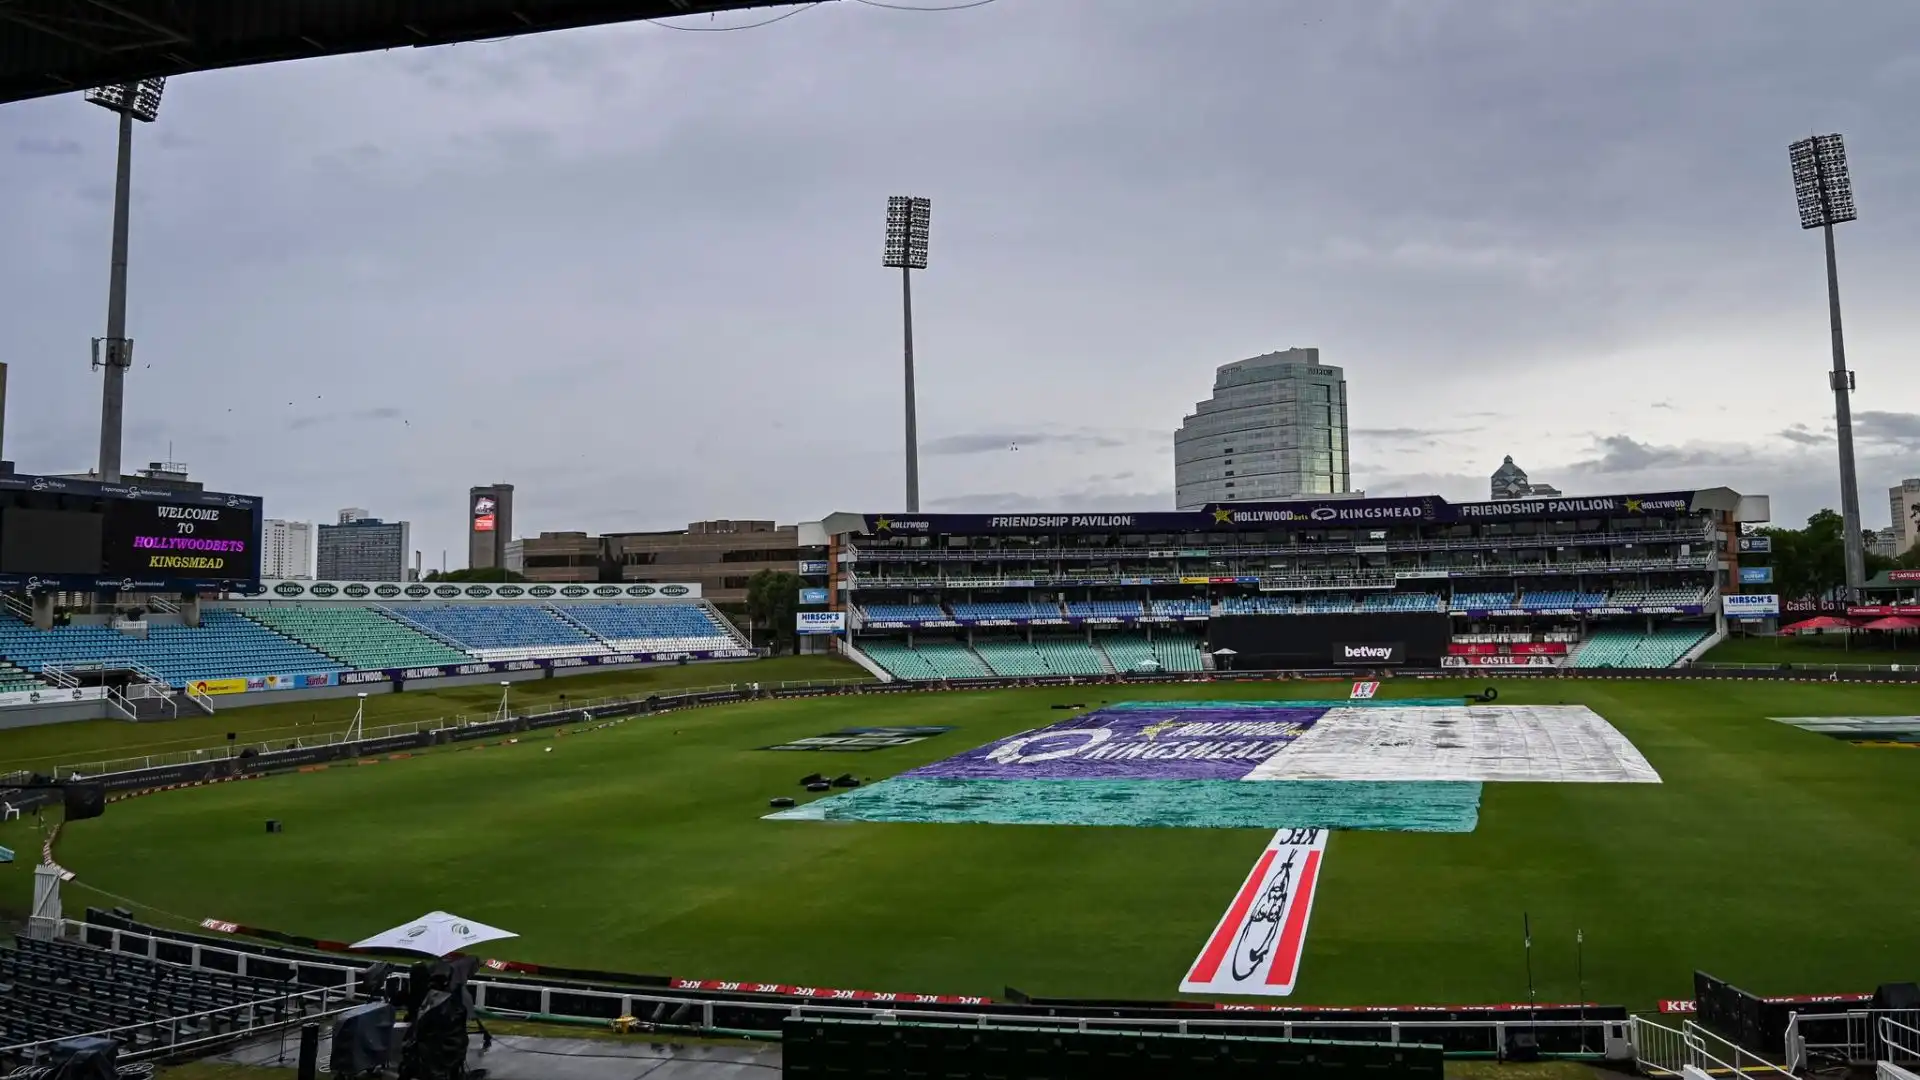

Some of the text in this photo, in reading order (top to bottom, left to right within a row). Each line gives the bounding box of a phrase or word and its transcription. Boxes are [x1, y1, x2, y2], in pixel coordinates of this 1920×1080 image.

[1463, 498, 1614, 516] FRIENDSHIP PAVILION
[1641, 499, 1685, 509] HOLLYWOOD
[158, 506, 219, 520] WELCOME
[1340, 506, 1422, 520] KINGSMEAD
[890, 521, 929, 529] HOLLYWOOD
[992, 515, 1131, 527] FRIENDSHIP PAVILION
[177, 523, 194, 534] TO
[133, 536, 245, 552] HOLLYWOODBETS
[149, 555, 224, 569] KINGSMEAD
[1728, 595, 1773, 604] HIRSCH'S
[801, 613, 840, 621] HIRSCH'S
[1345, 645, 1393, 660] betway
[1480, 656, 1515, 664] CASTLE
[1279, 828, 1320, 845] KFC
[679, 980, 982, 1004] KFC KFC KFC KFC KFC KFC KFC KFC
[1667, 1000, 1697, 1011] KFC
